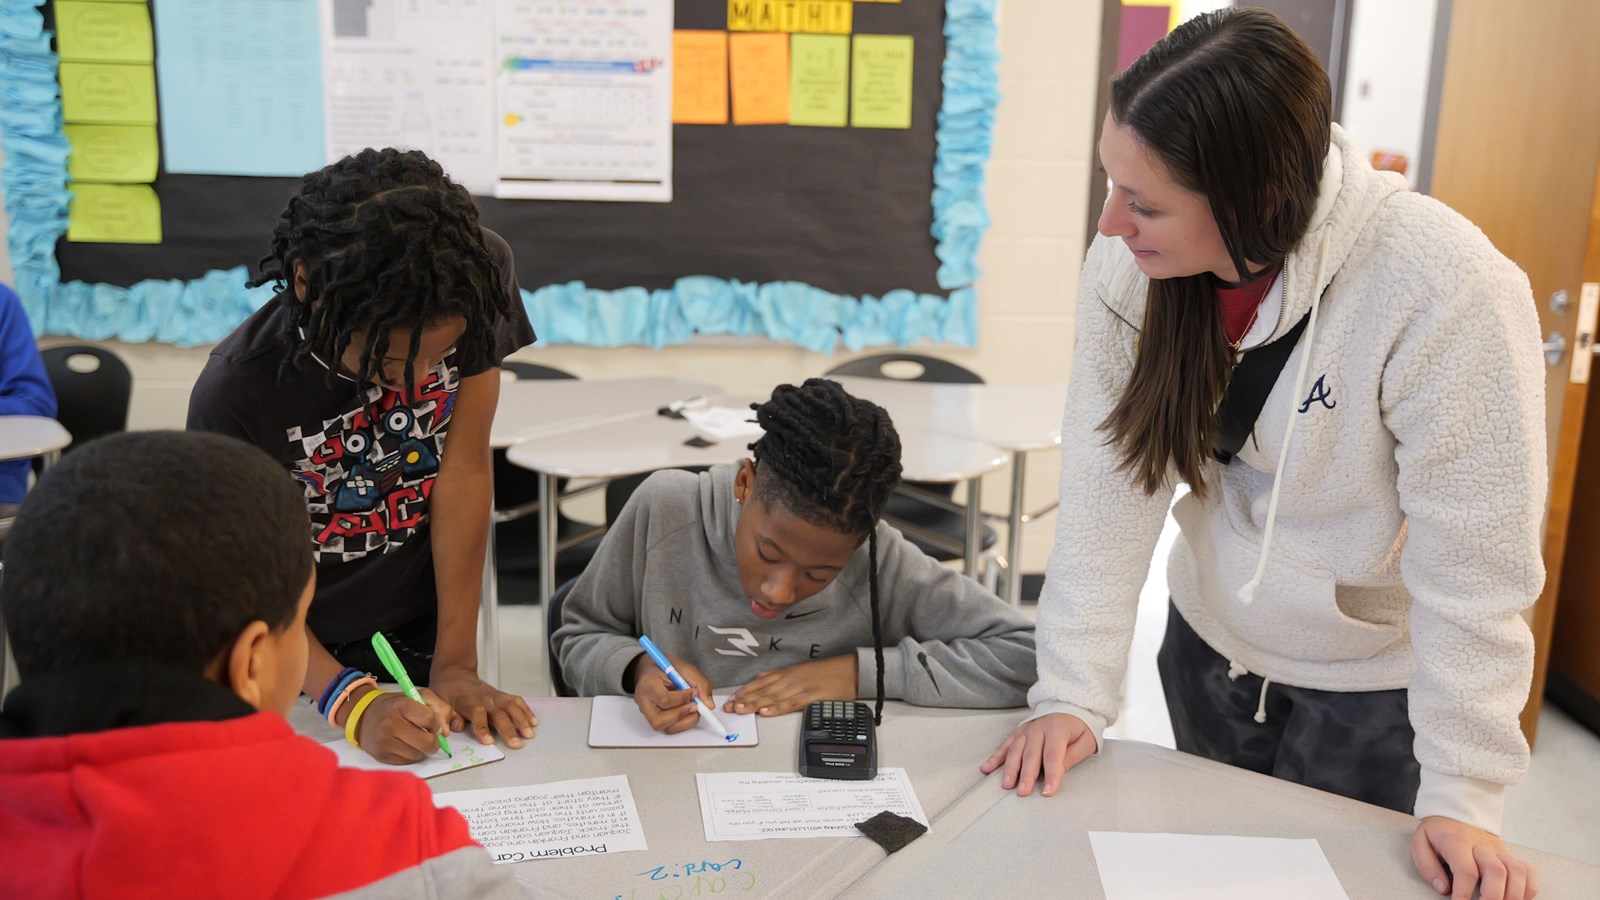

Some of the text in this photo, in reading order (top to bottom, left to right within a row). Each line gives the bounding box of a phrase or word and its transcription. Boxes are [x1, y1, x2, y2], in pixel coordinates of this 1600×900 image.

[731, 2, 842, 25] MATH!
[316, 480, 434, 542] FAC
[593, 828, 630, 837] Jaquan
[493, 844, 607, 862] Problem Car
